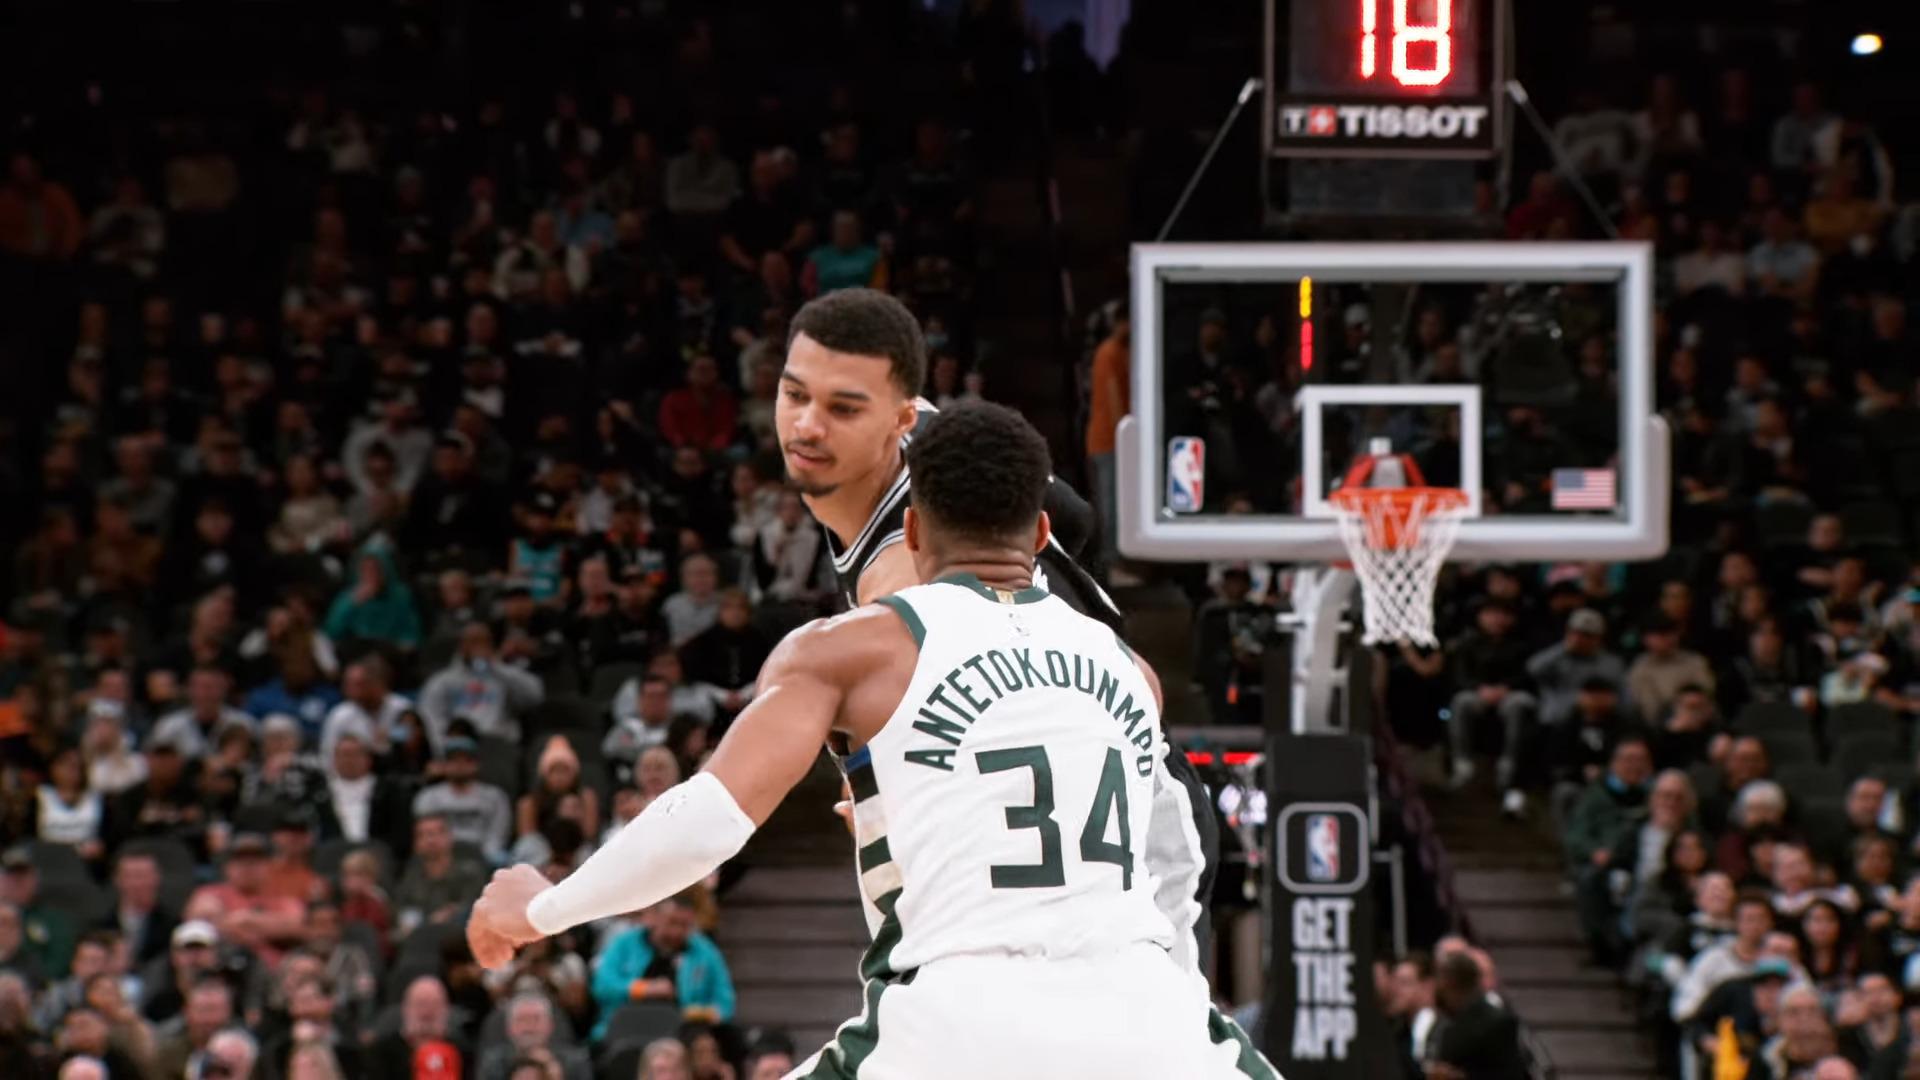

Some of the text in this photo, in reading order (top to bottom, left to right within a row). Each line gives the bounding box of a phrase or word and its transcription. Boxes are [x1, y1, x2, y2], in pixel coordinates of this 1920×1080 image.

[1360, 0, 1452, 86] 18
[1337, 105, 1488, 137] TISSOT
[904, 648, 1154, 778] ANTETOKOUNMPO
[975, 744, 1135, 892] 34
[1292, 898, 1354, 950] GET
[1292, 953, 1355, 1005] THE
[1292, 1006, 1357, 1061] APP
